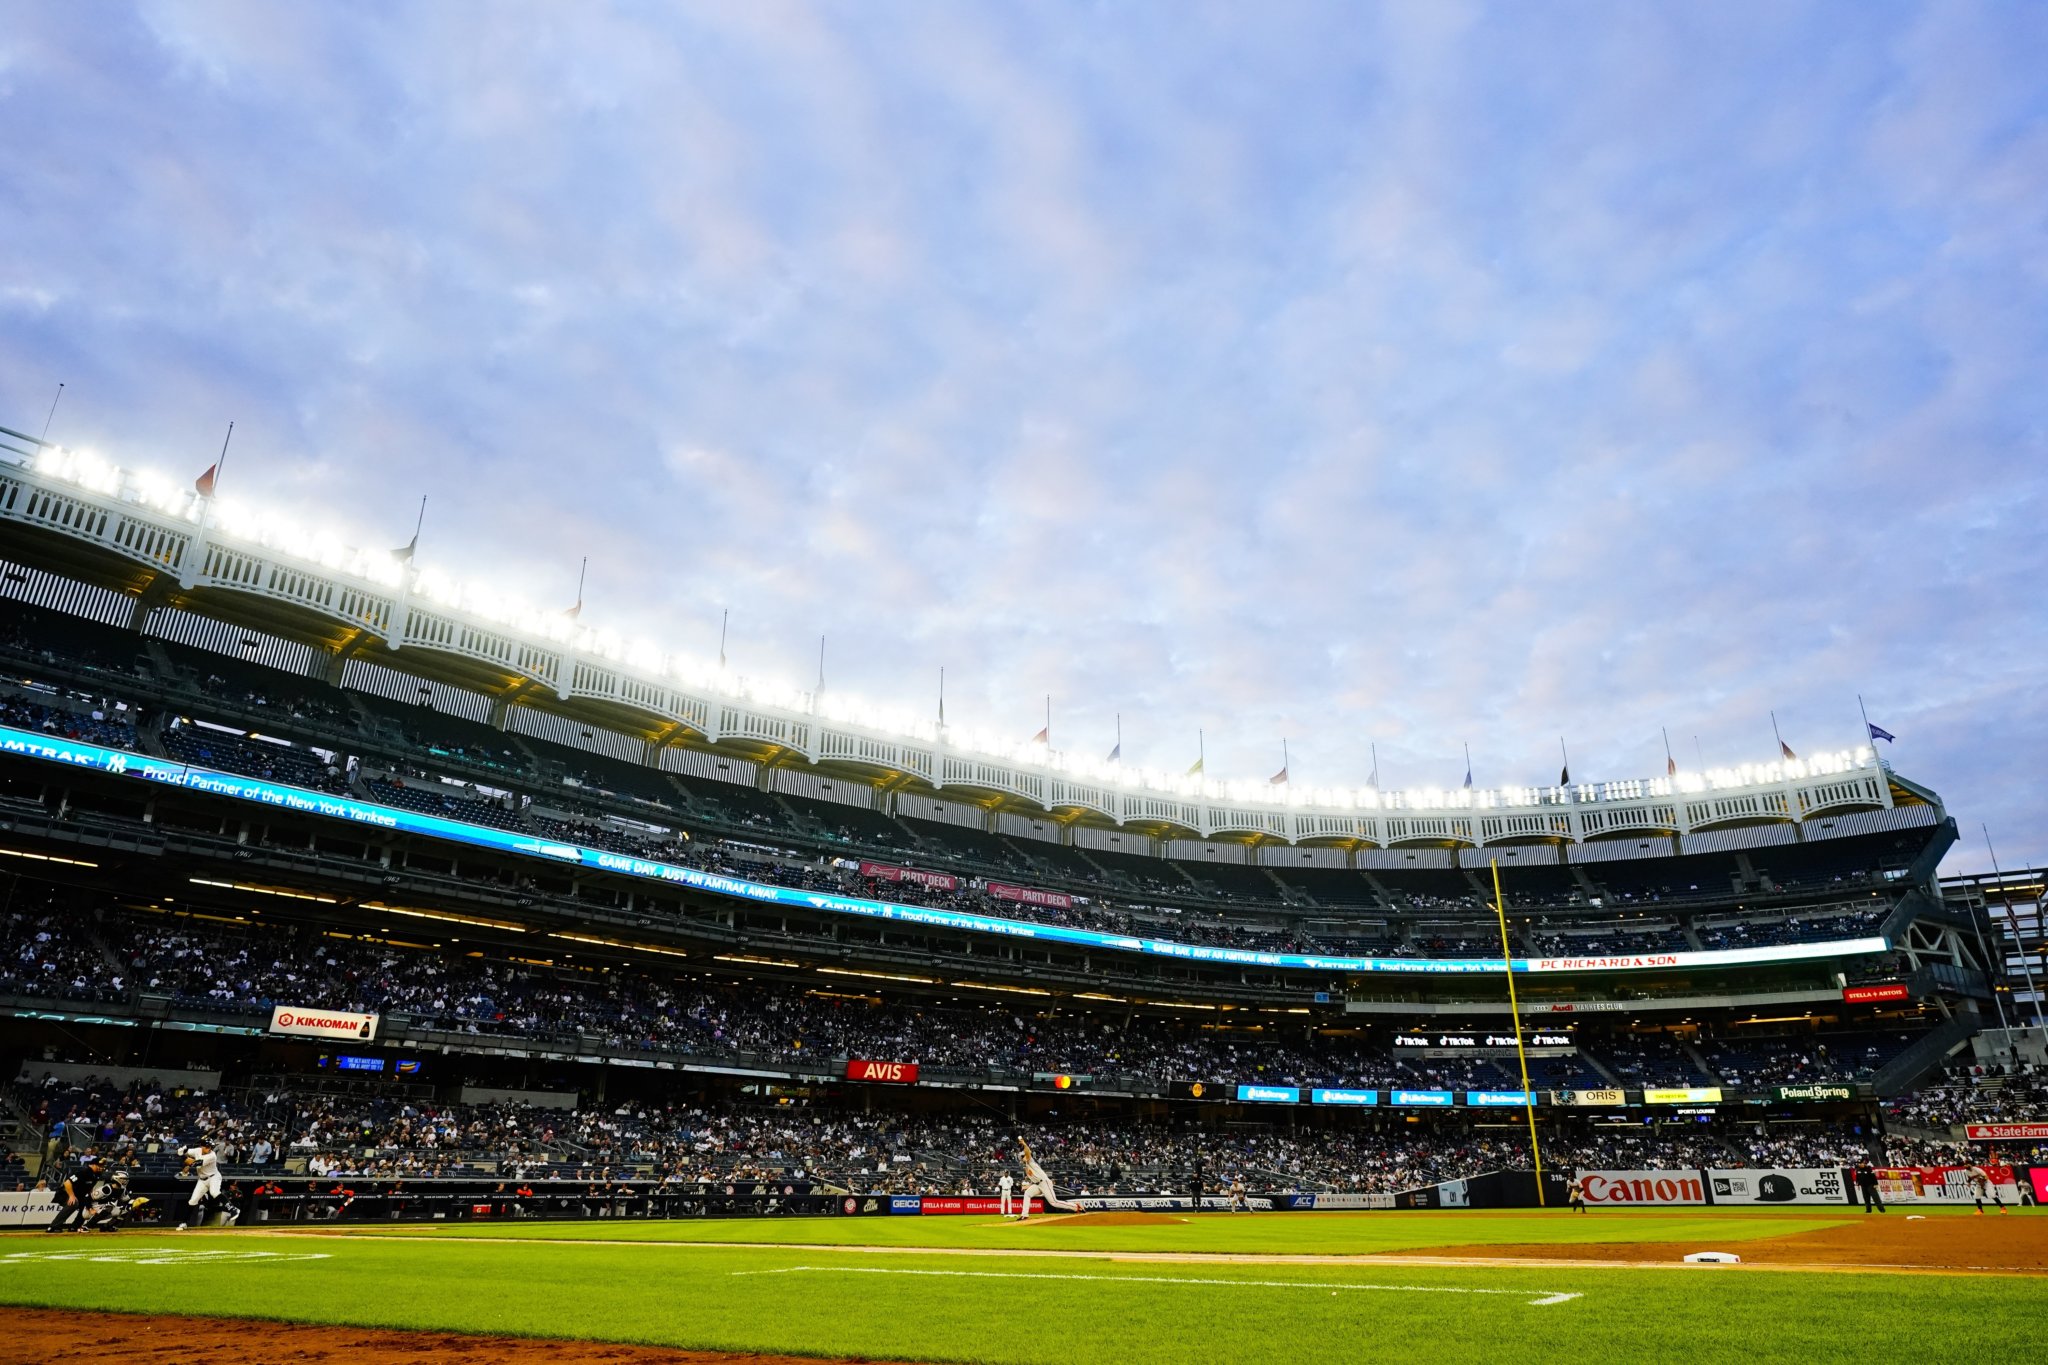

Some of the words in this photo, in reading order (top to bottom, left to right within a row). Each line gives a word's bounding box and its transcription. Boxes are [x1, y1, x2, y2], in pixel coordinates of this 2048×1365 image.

[143, 765, 188, 785] Proud
[190, 775, 243, 795] Partner
[244, 787, 260, 799] of
[261, 789, 283, 803] the
[285, 794, 316, 811] New
[319, 801, 346, 816] York
[348, 807, 397, 826] Yankees
[598, 855, 632, 871] GAME
[661, 867, 686, 881] JUST
[687, 873, 702, 885] AN
[704, 876, 746, 894] AMTRAK
[900, 870, 927, 883] PARTY
[928, 874, 950, 888] DECK
[1022, 890, 1046, 903] PARTY
[1047, 894, 1067, 906] DECK
[1541, 960, 1558, 969] PC
[1563, 958, 1630, 969] RICHARD
[1647, 956, 1677, 965] SON
[1879, 989, 1902, 997] ARTOIS
[1551, 1004, 1573, 1012] Audi
[1606, 1003, 1623, 1011] CLUB
[296, 1016, 358, 1030] KIKKOMAN
[1403, 1036, 1429, 1047] TikTok
[1449, 1036, 1475, 1047] TikTok
[1542, 1035, 1570, 1045] TikTok
[864, 1063, 902, 1080] AVIS
[1586, 1091, 1617, 1101] ORIS
[1780, 1086, 1814, 1099] Poland
[1814, 1086, 1849, 1099] Spring
[1993, 1126, 2018, 1136] State
[2022, 1126, 2048, 1136] Farm
[1581, 1175, 1703, 1203] Canon
[1800, 1187, 1840, 1195] GLORY
[893, 1200, 920, 1208] GEICO
[1083, 1199, 1103, 1208] COOL
[1120, 1199, 1139, 1208] COOL
[1155, 1199, 1173, 1208] COOL
[1295, 1197, 1311, 1205] ACC
[21, 1205, 35, 1213] OF
